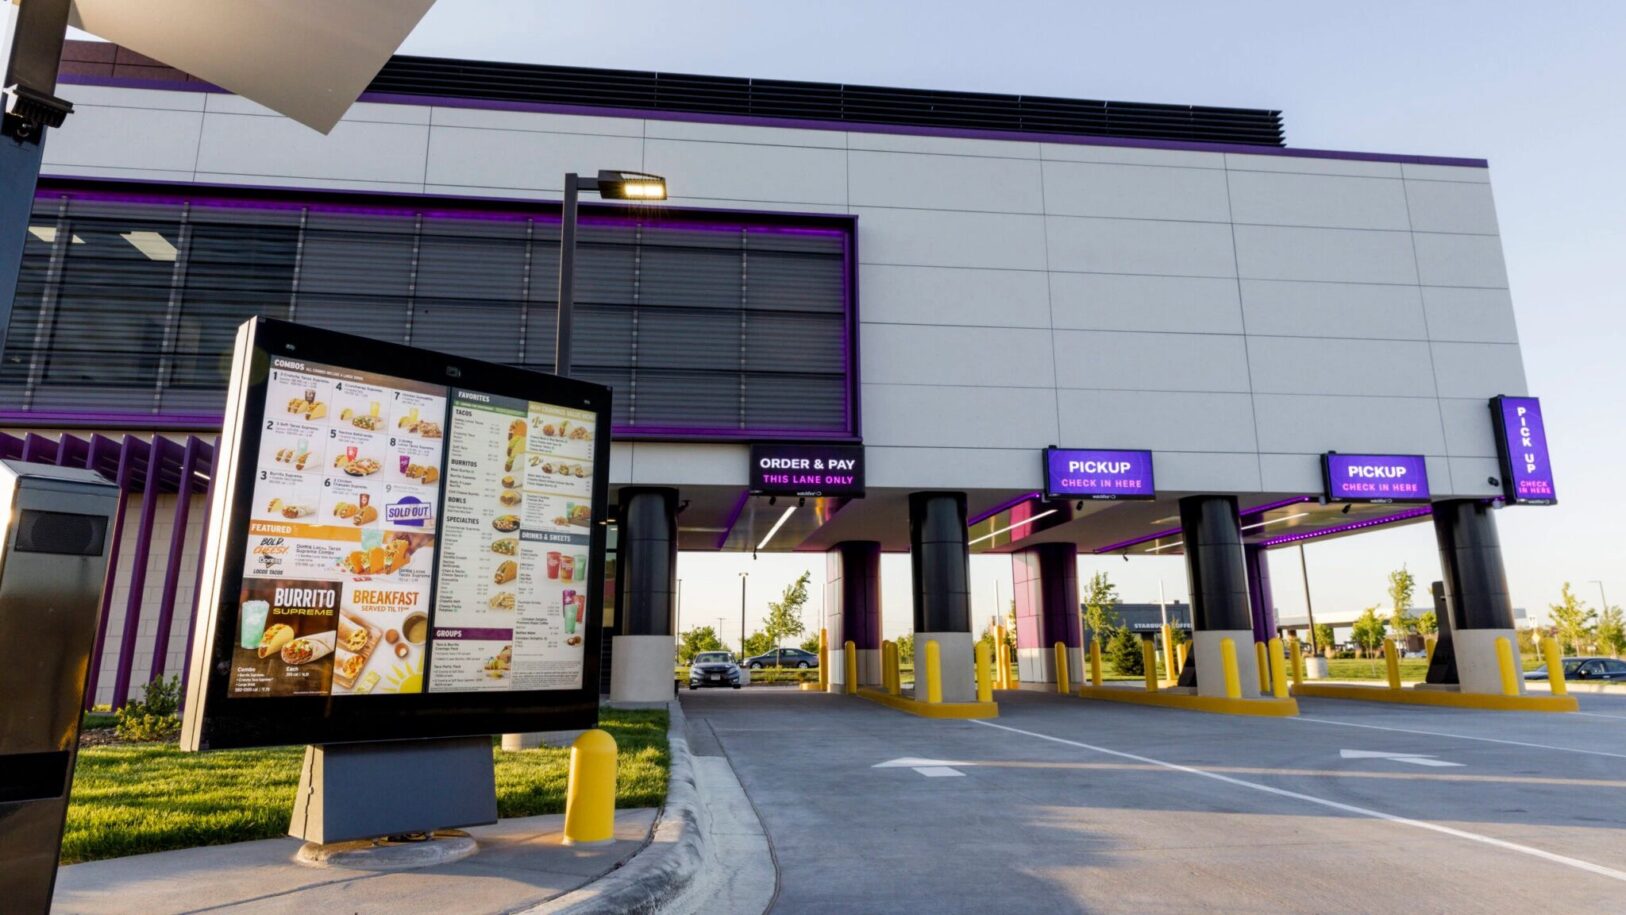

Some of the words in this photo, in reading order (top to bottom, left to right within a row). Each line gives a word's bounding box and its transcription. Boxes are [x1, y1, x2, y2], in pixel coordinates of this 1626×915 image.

[274, 359, 304, 370] COMBOS
[273, 371, 277, 380] 1
[336, 382, 342, 391] 4
[395, 392, 400, 400] 7
[458, 391, 490, 402] FAVORITES
[267, 421, 273, 430] 2
[330, 430, 336, 438] 5
[390, 438, 396, 446] 8
[451, 459, 477, 467] BURRITOS
[760, 458, 810, 469] ORDER
[814, 459, 824, 469] &
[828, 460, 855, 470] PAY
[1069, 461, 1131, 473] PICKUP
[261, 471, 267, 480] 3
[1348, 466, 1406, 478] PICKUP
[324, 478, 330, 487] 6
[763, 475, 789, 483] THIS
[825, 476, 853, 484] ONLY
[386, 484, 392, 493] 9
[389, 507, 410, 518] SOLD
[412, 507, 428, 516] OUT
[447, 516, 479, 524] SPECIALTIES
[252, 524, 292, 533] FEATURED
[274, 587, 335, 608] BURRITO
[353, 590, 419, 605] BREAKFAST
